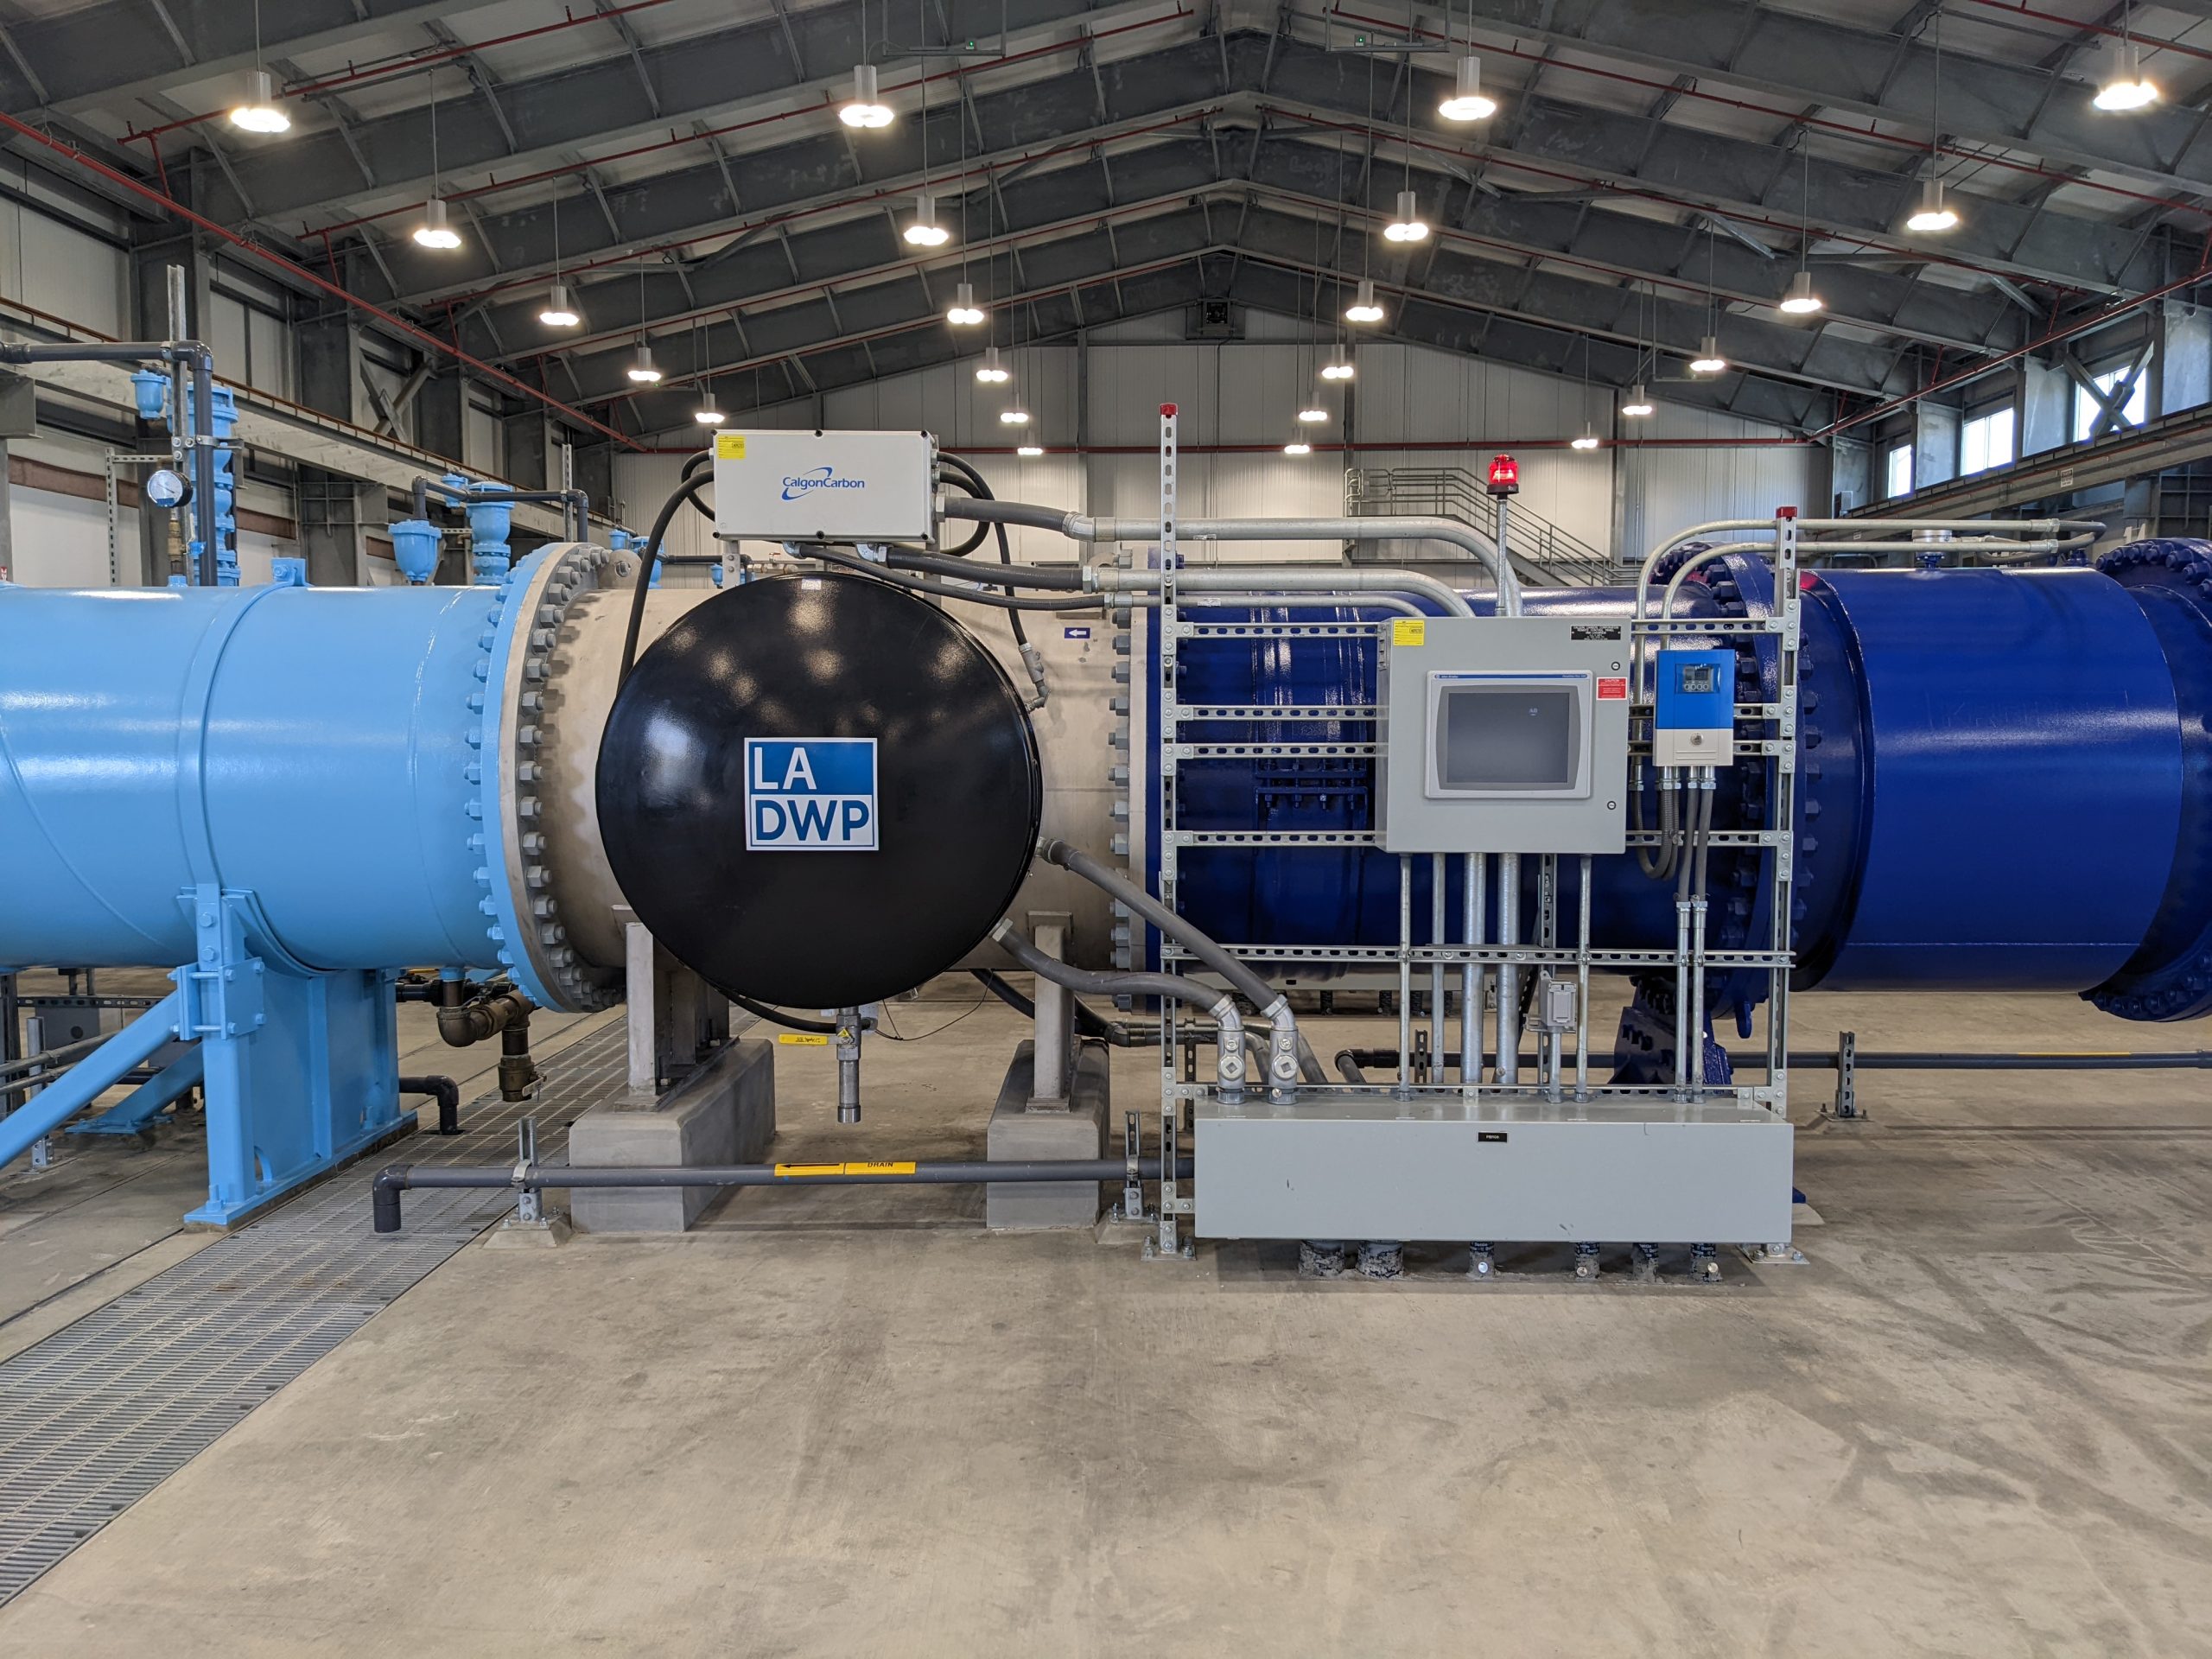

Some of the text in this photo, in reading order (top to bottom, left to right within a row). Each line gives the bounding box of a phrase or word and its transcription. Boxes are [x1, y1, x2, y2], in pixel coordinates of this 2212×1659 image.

[782, 477, 865, 490] CalgonCarbon
[754, 747, 817, 790] LA
[755, 799, 869, 841] DWP
